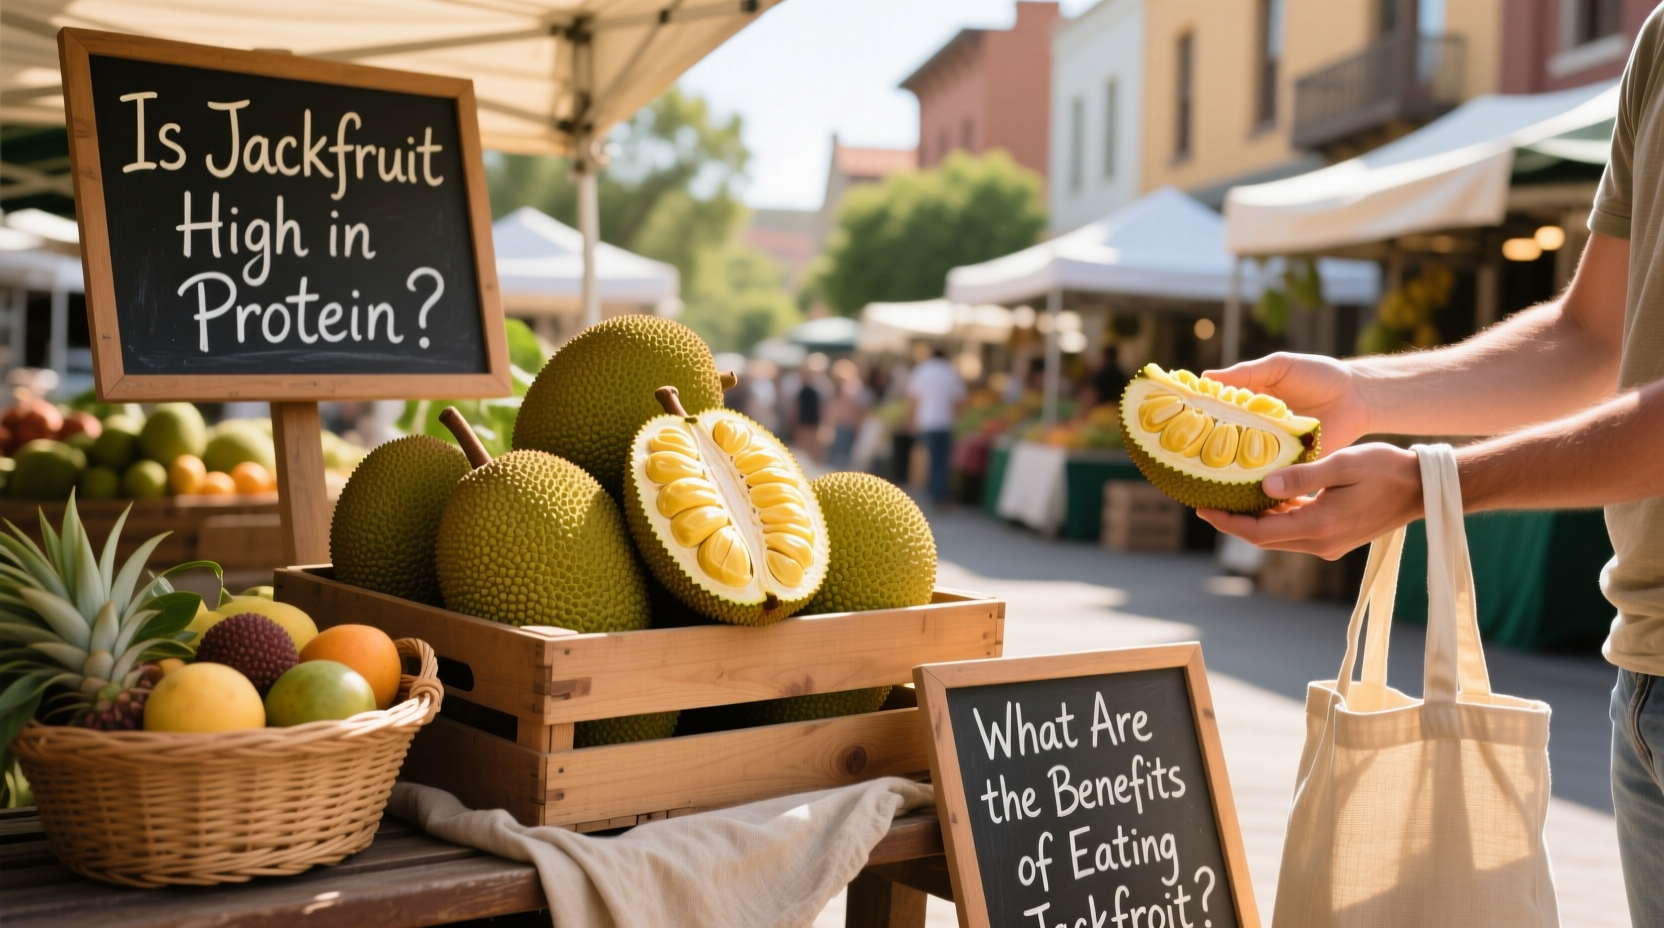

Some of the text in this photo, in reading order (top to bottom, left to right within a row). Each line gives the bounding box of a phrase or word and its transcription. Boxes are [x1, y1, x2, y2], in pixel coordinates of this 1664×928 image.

[119, 91, 444, 201] Is Jackfruit
[175, 190, 377, 287] High in
[177, 266, 445, 353] Protein?
[972, 690, 1153, 761] What Are
[980, 754, 1187, 825] the Benefits
[1017, 824, 1180, 892] of Eating
[1023, 865, 1217, 928] kfroit?
